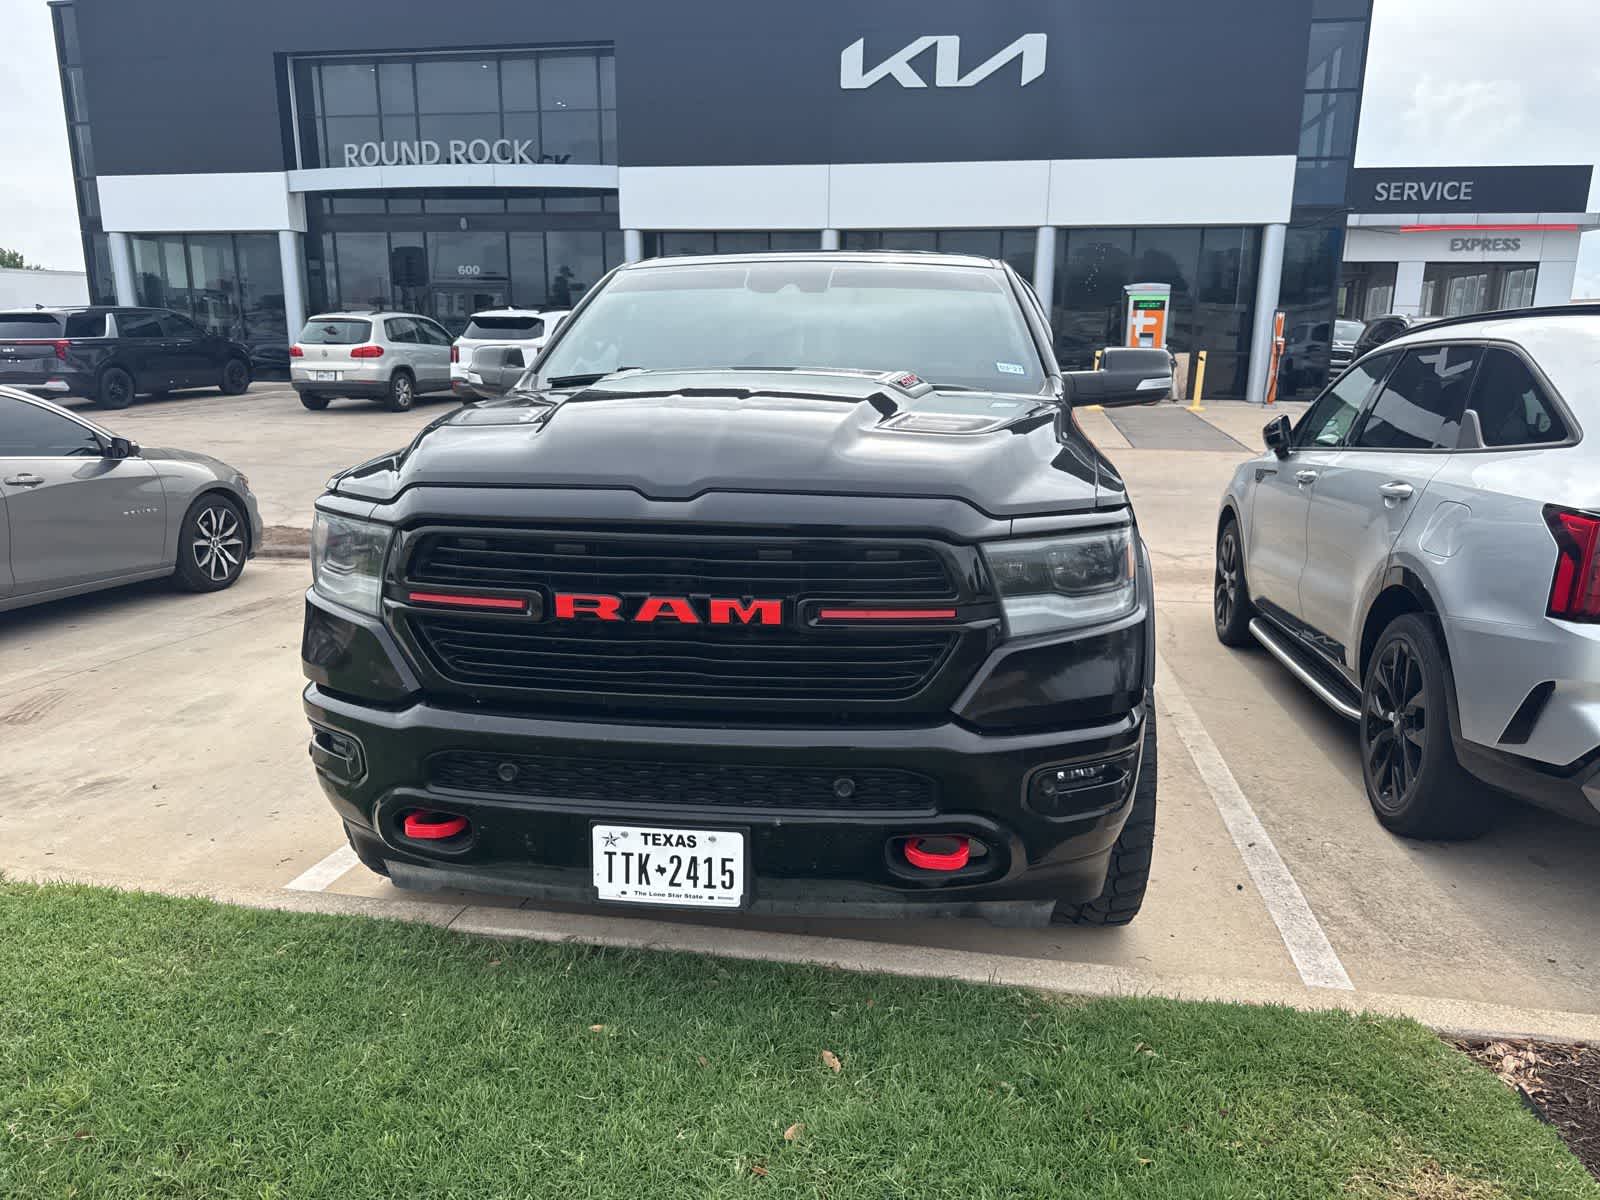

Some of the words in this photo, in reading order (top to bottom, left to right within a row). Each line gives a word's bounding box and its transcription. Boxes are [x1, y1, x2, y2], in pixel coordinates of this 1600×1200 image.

[840, 33, 1047, 89] KIA
[344, 140, 441, 167] ROUND
[449, 138, 535, 165] ROCK
[1374, 181, 1474, 201] SERVICE
[1449, 237, 1521, 252] EXPRESS
[457, 265, 481, 275] 600
[554, 592, 783, 625] RAM
[640, 832, 697, 848] TEXAS
[603, 851, 651, 886] TTK
[668, 854, 735, 890] 2415
